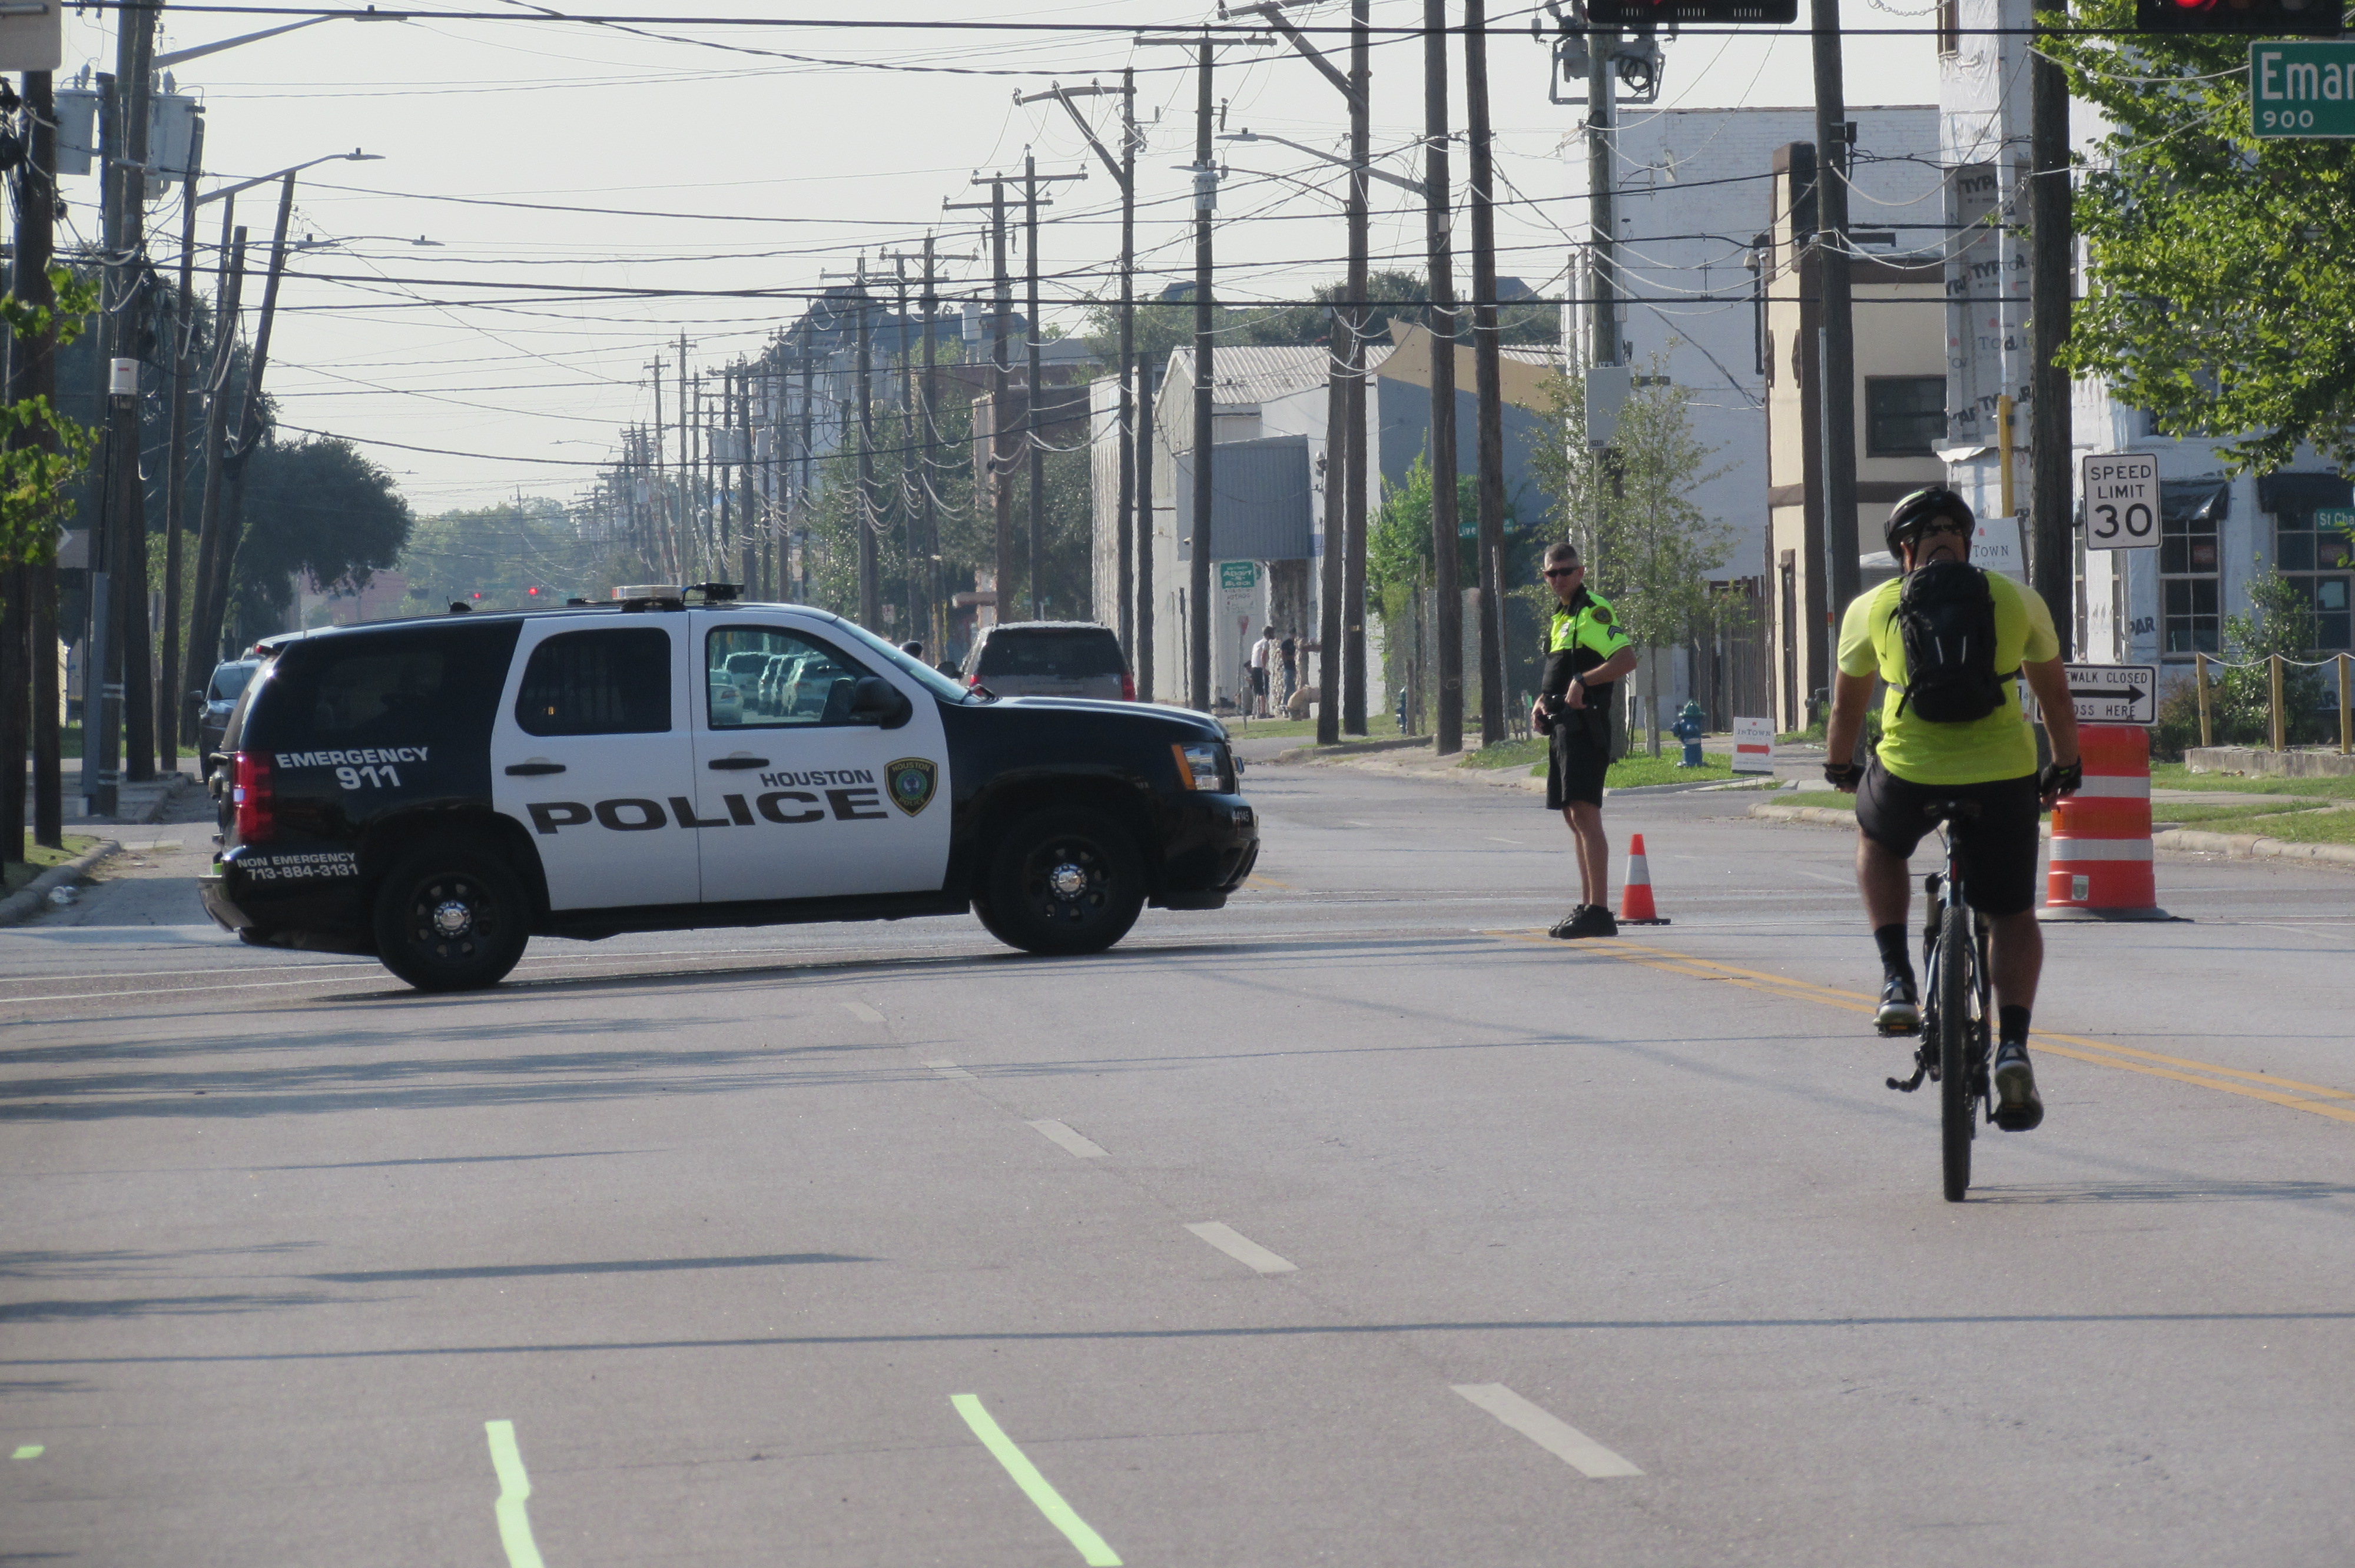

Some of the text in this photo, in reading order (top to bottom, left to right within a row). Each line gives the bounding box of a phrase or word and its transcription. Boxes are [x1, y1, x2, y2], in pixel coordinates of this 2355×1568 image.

[2263, 110, 2314, 128] 900
[2091, 464, 2151, 481] SPEED
[2098, 484, 2145, 499] LIMIT
[2094, 503, 2152, 539] 30
[2107, 672, 2148, 683] CLOSED
[2106, 705, 2136, 716] HERE
[275, 746, 428, 768] EMERGENCY
[891, 762, 931, 772] HOUSTON
[335, 765, 401, 789] 911
[759, 769, 874, 788] HOUSTON
[897, 796, 925, 806] POLICE
[525, 787, 889, 835] POLICE
[237, 852, 356, 868] NON EMERGENCY
[246, 863, 359, 881] 713-884-3131
